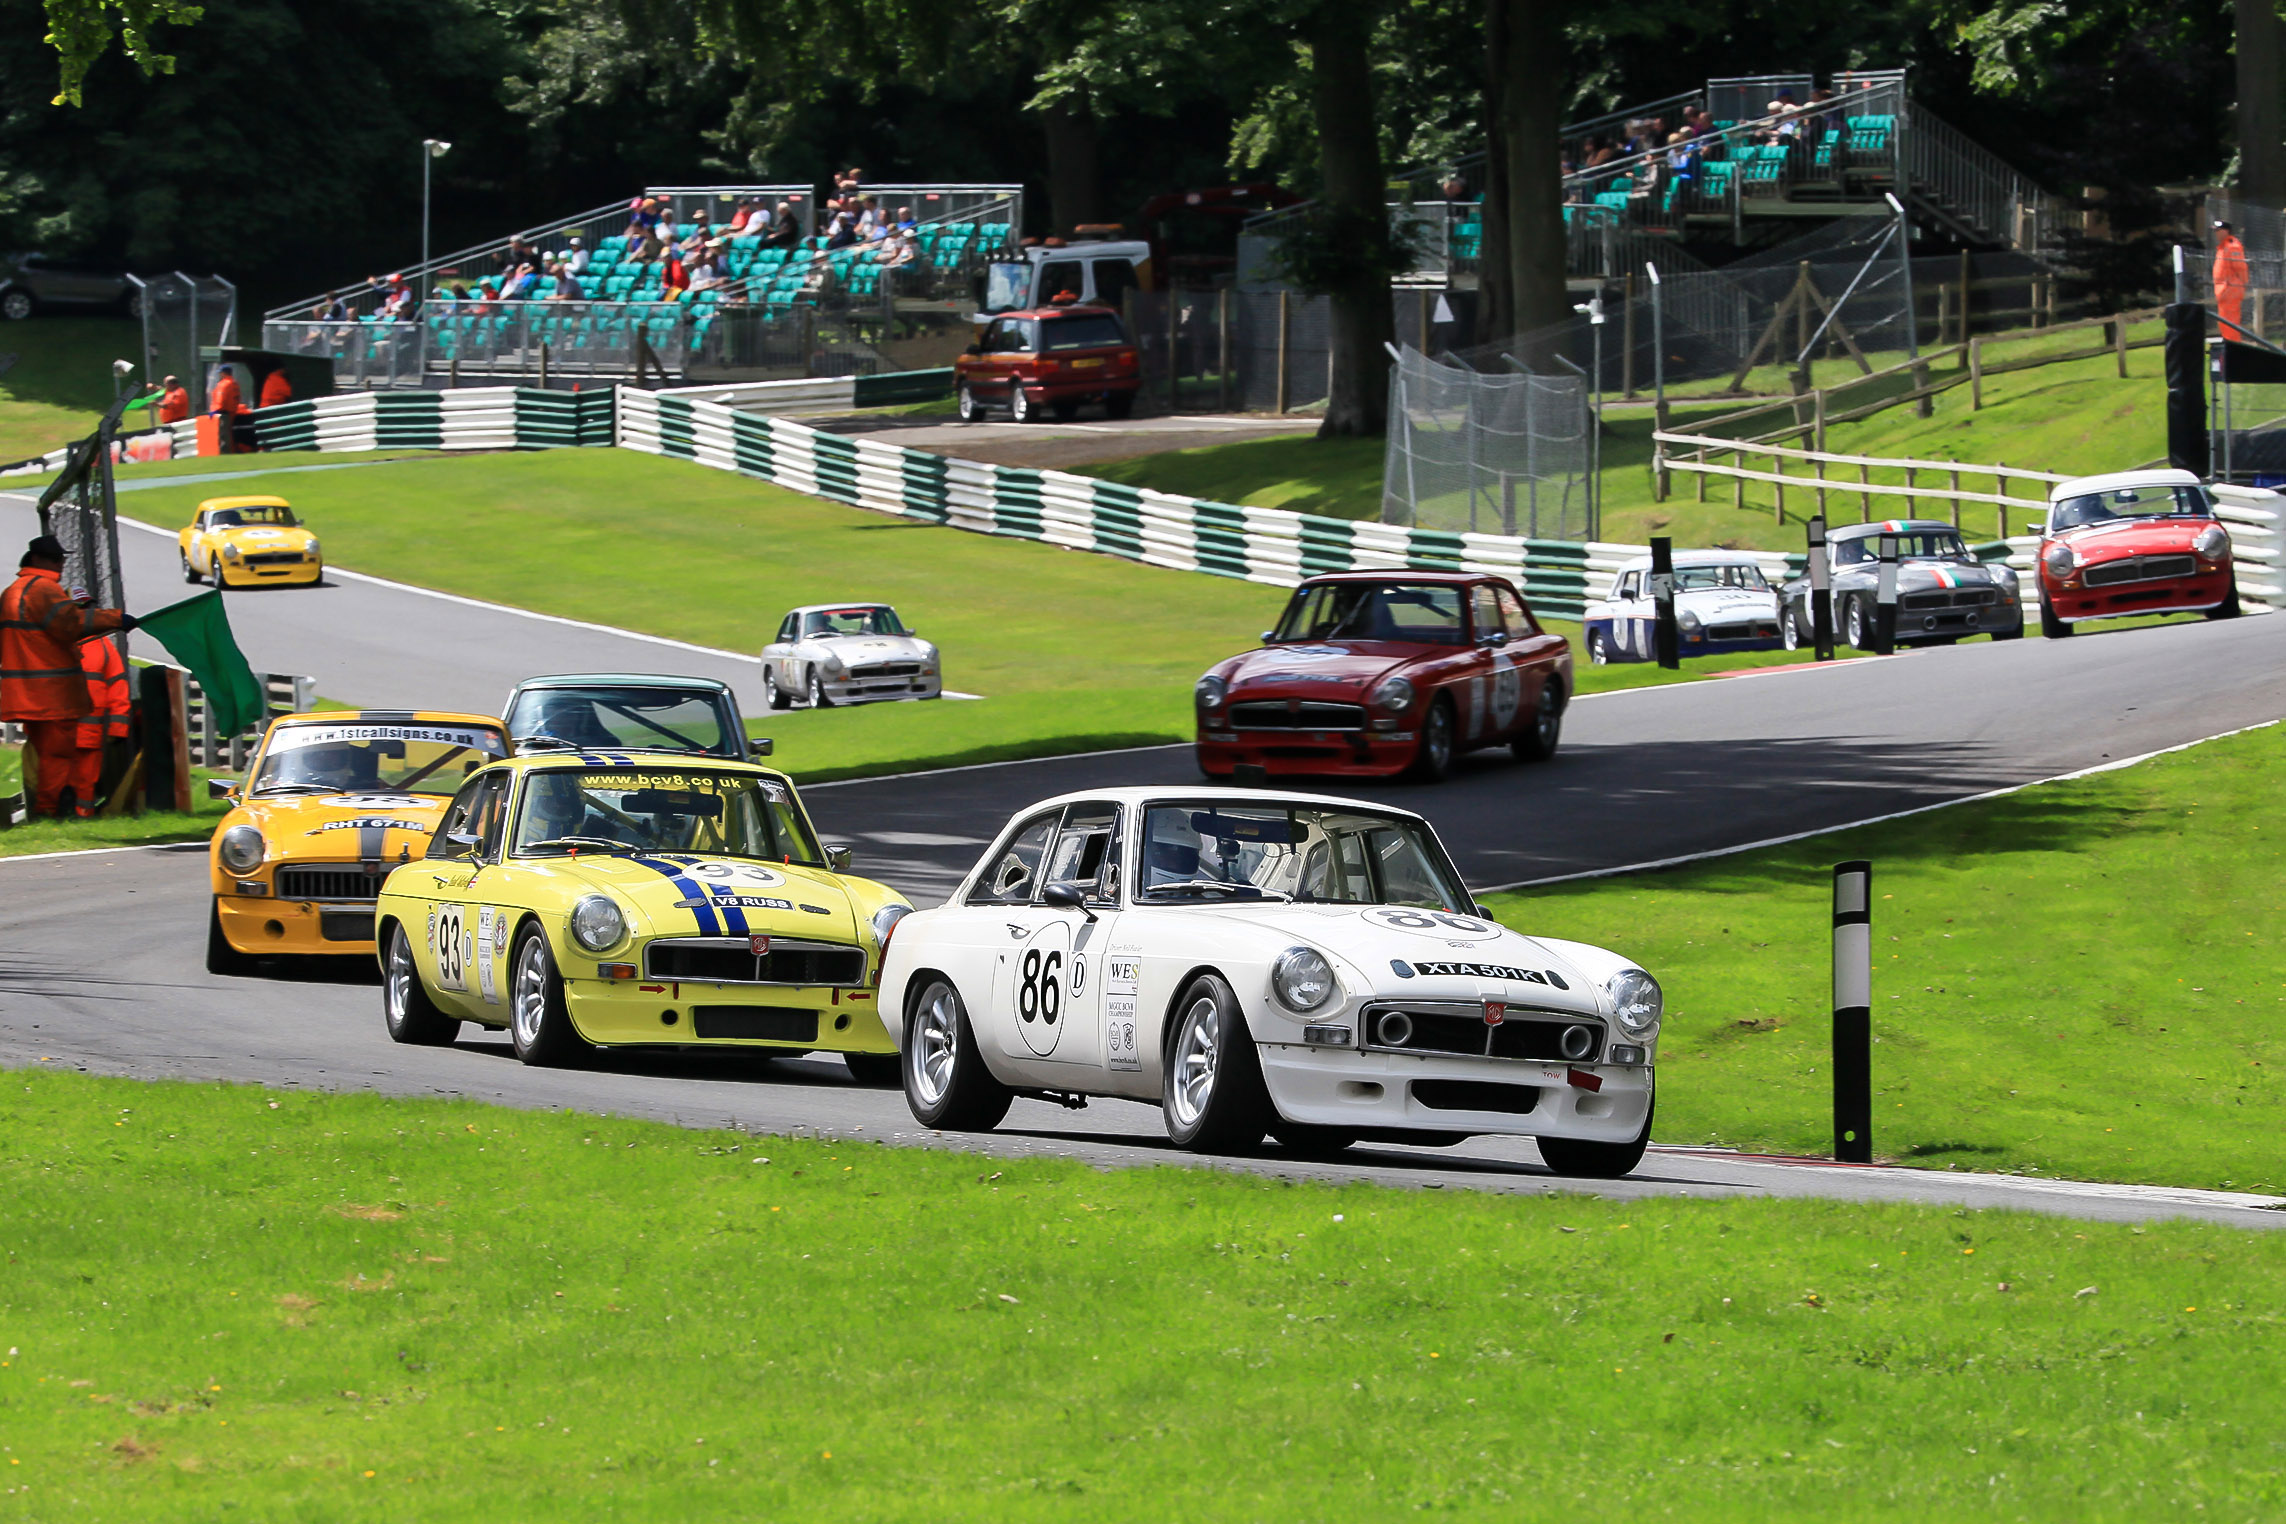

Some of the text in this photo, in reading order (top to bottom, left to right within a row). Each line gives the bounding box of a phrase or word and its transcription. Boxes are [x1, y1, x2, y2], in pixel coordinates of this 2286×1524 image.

[301, 727, 474, 746] www.1stcallsigns.co.uk
[323, 819, 425, 831] RHT 671M
[696, 864, 774, 881] 93
[715, 897, 789, 908] V8 RUSS
[1377, 910, 1488, 932] 86
[439, 914, 461, 980] 93
[1073, 961, 1085, 989] D
[1111, 963, 1138, 980] WES
[1423, 962, 1540, 983] XTA 501K
[1020, 949, 1061, 1025] 86
[1543, 1071, 1561, 1080] TOW
